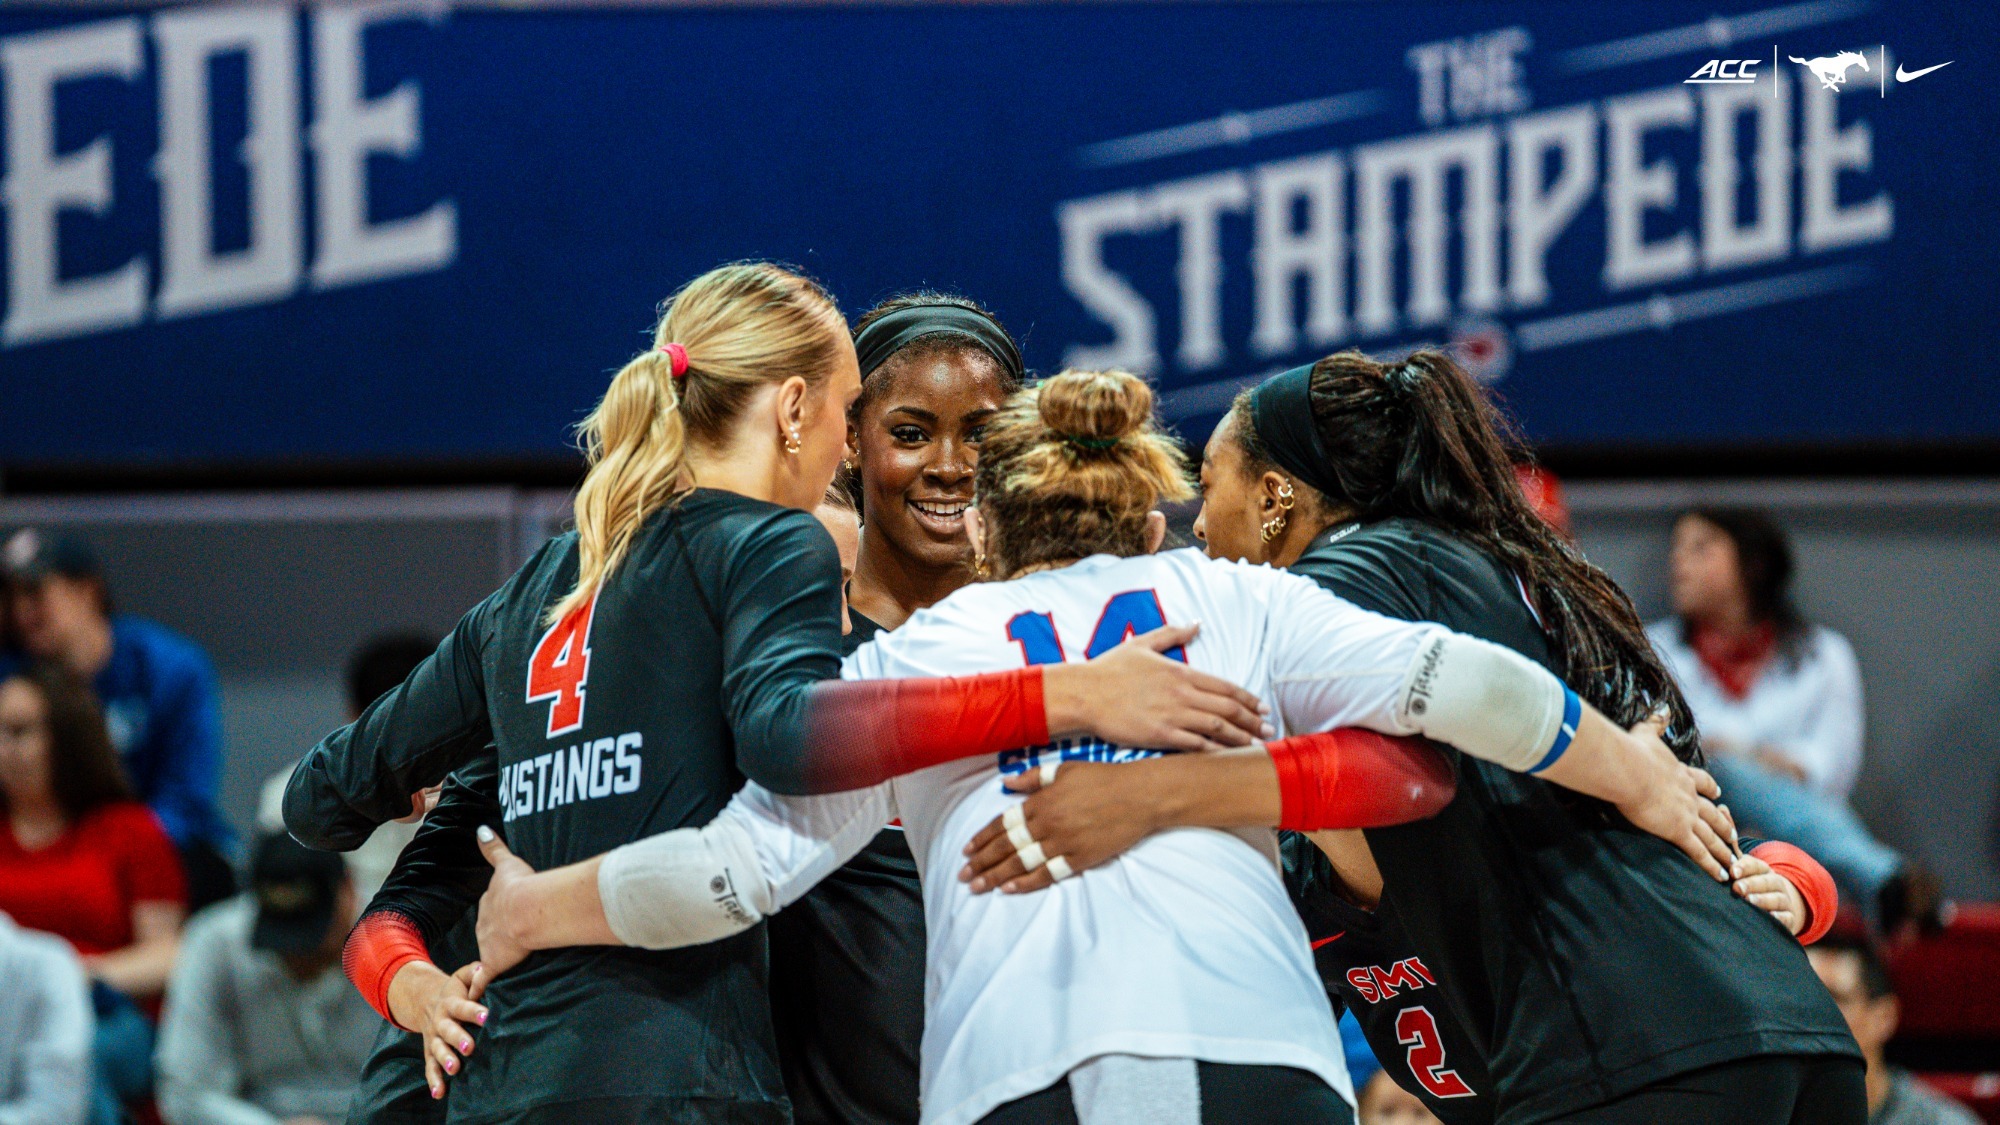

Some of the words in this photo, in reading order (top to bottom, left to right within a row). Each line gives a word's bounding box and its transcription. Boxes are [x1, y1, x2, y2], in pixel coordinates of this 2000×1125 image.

[1405, 27, 1532, 124] THE
[1060, 50, 1893, 374] STAMPEDE
[526, 577, 606, 739] 4
[1395, 1005, 1477, 1099] 2
